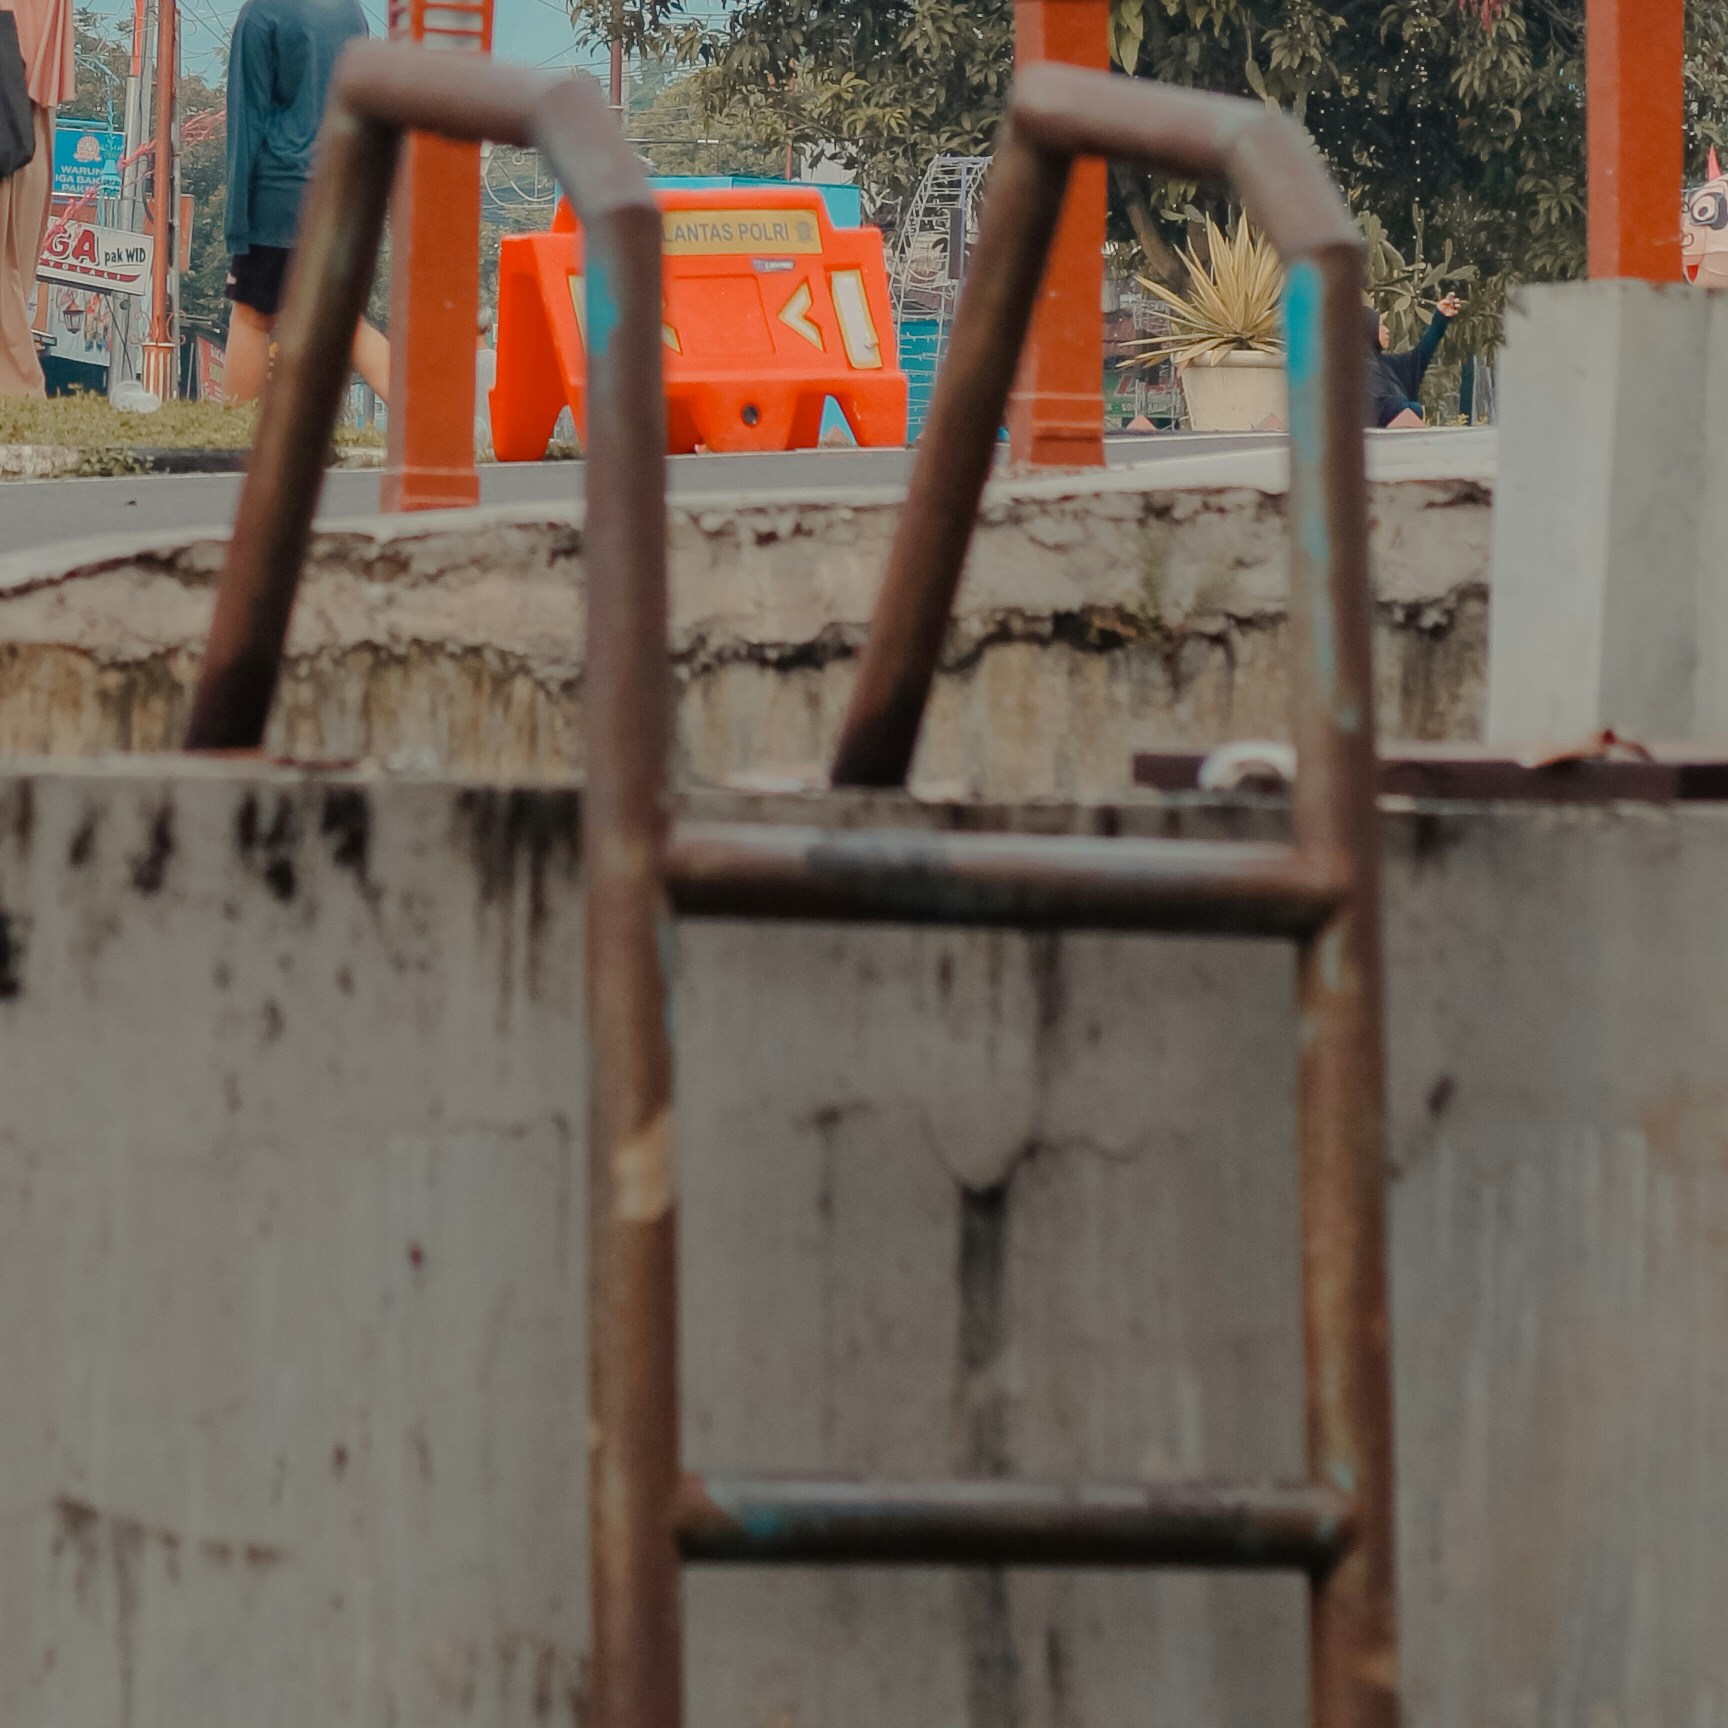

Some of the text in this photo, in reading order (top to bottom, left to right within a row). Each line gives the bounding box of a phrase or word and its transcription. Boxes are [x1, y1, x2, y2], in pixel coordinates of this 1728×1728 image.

[62, 184, 84, 193] PAK
[738, 222, 790, 241] POLRI
[104, 246, 123, 266] pak
[125, 247, 146, 263] WID
